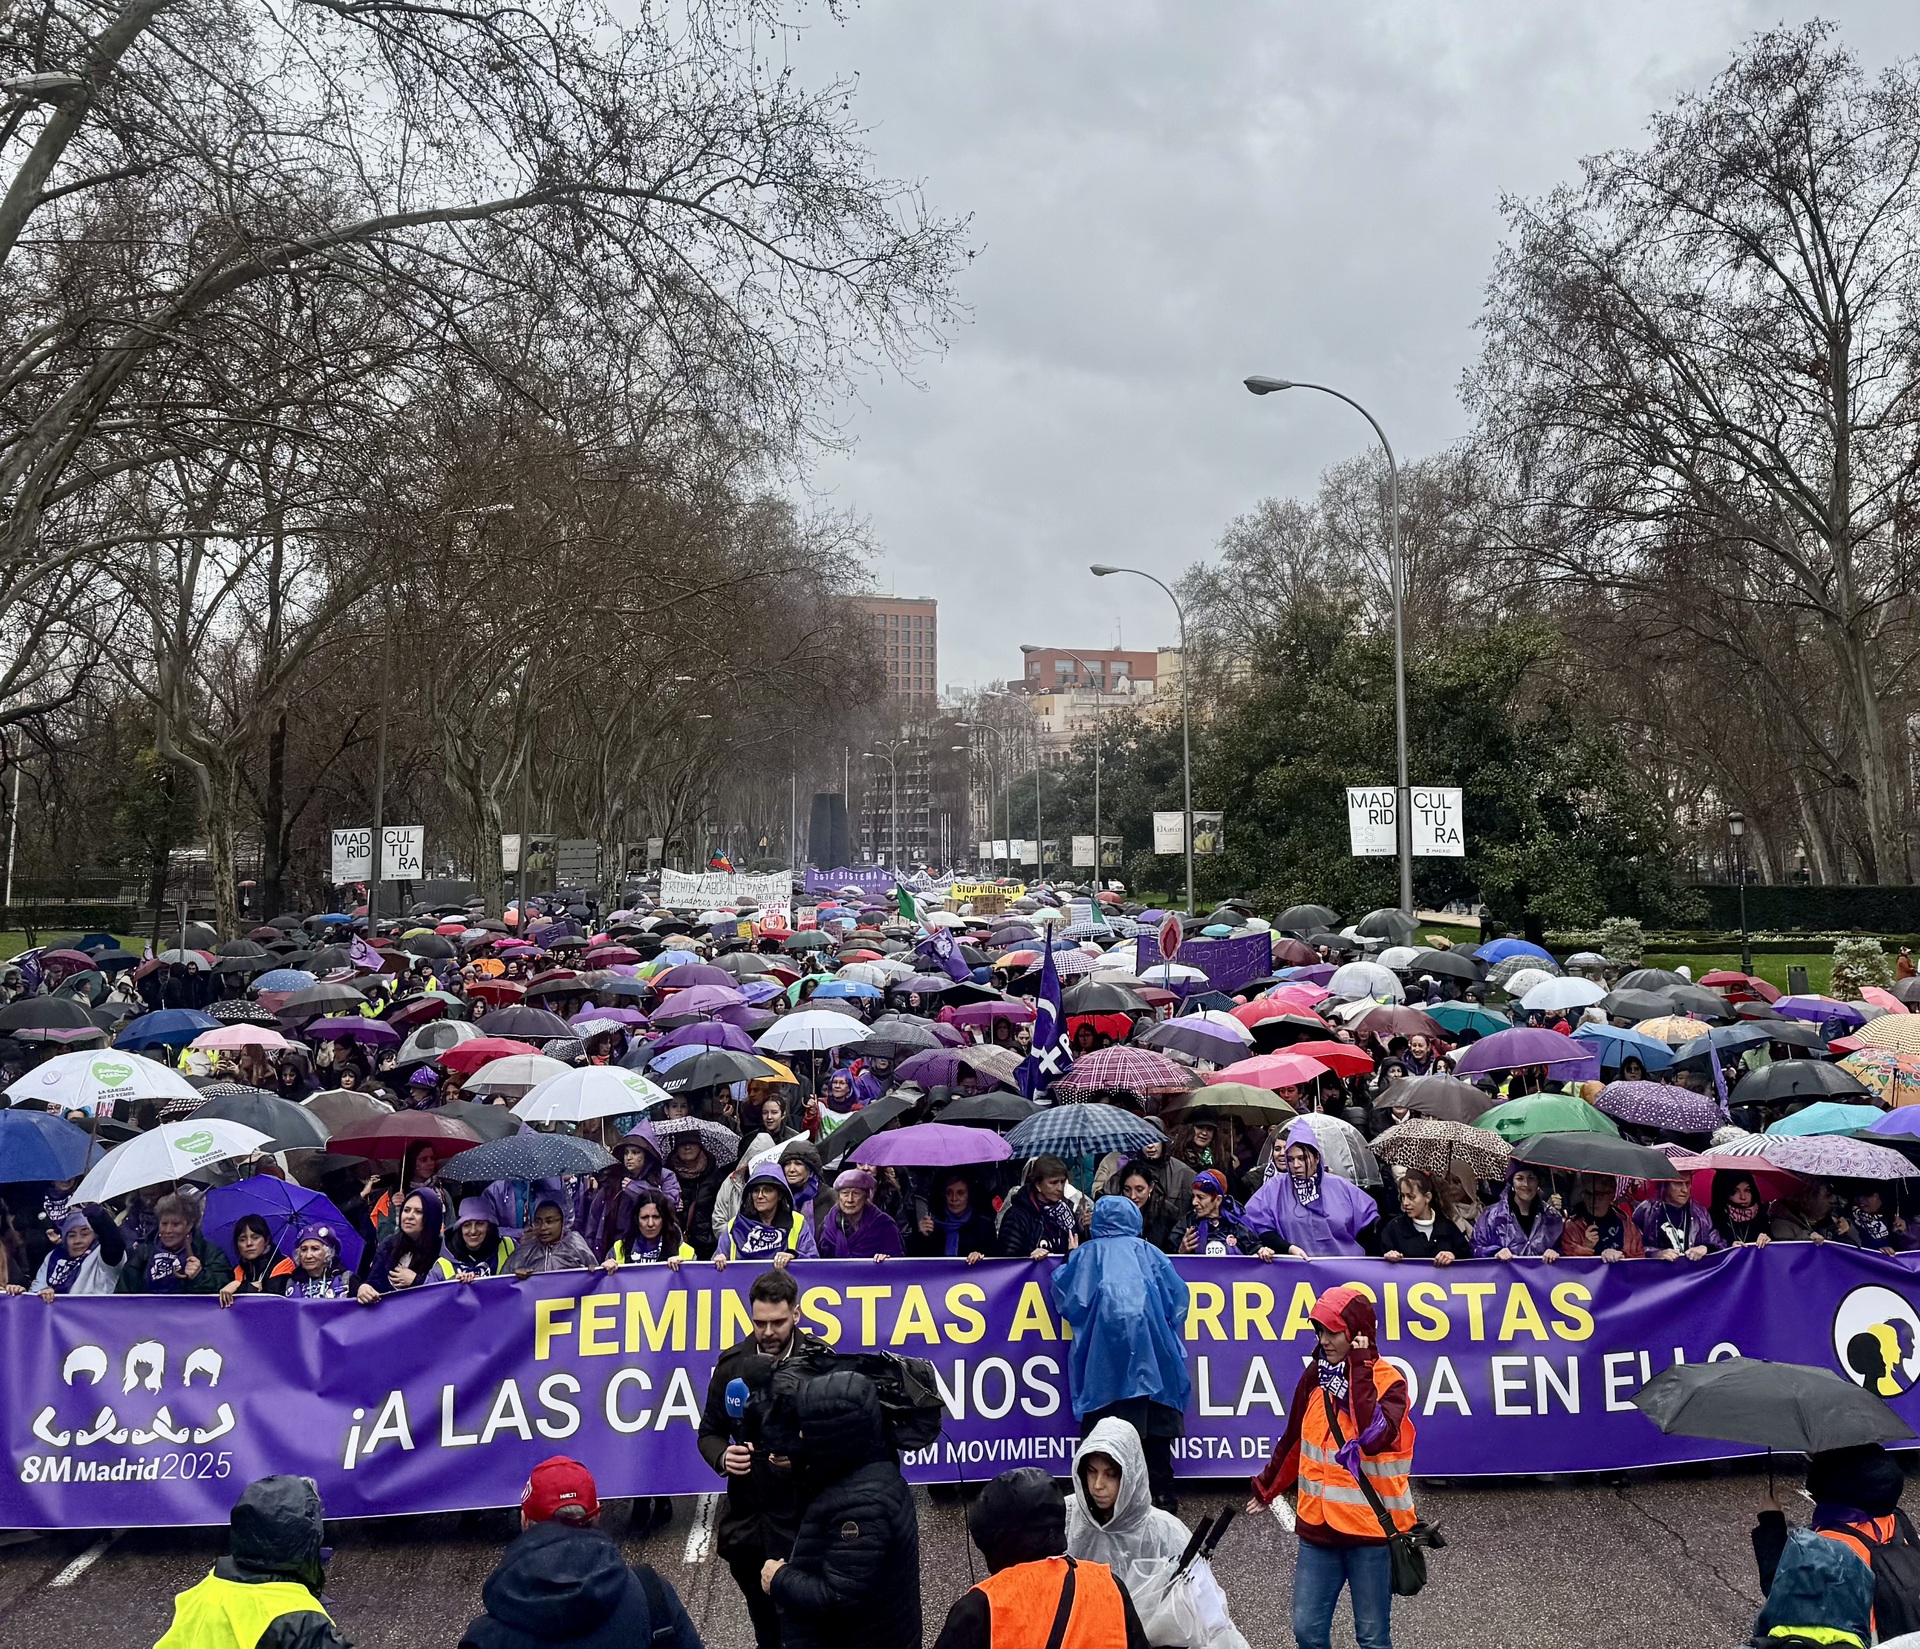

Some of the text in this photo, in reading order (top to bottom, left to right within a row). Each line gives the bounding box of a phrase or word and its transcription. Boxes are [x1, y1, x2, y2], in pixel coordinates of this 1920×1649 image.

[1350, 792, 1394, 808] MAD
[1414, 793, 1452, 809] CUL
[1368, 809, 1394, 825] RID
[1420, 810, 1446, 826] TU
[334, 832, 370, 846] MAD
[384, 831, 414, 843] CUL
[1435, 828, 1460, 844] RA
[347, 845, 370, 858] RID
[389, 844, 408, 856] TU
[399, 857, 419, 869] RA
[839, 871, 878, 880] SISTEMA
[957, 885, 977, 893] STOP
[534, 1283, 987, 1361] FEMINSTAS
[441, 1373, 581, 1447] LAS
[1197, 1356, 1285, 1416] LA
[1491, 1356, 1580, 1416] EN
[727, 1395, 741, 1406] tve
[946, 1437, 1081, 1463] MOVIMIENT
[1241, 1437, 1272, 1459] DE
[20, 1455, 71, 1483] 8M
